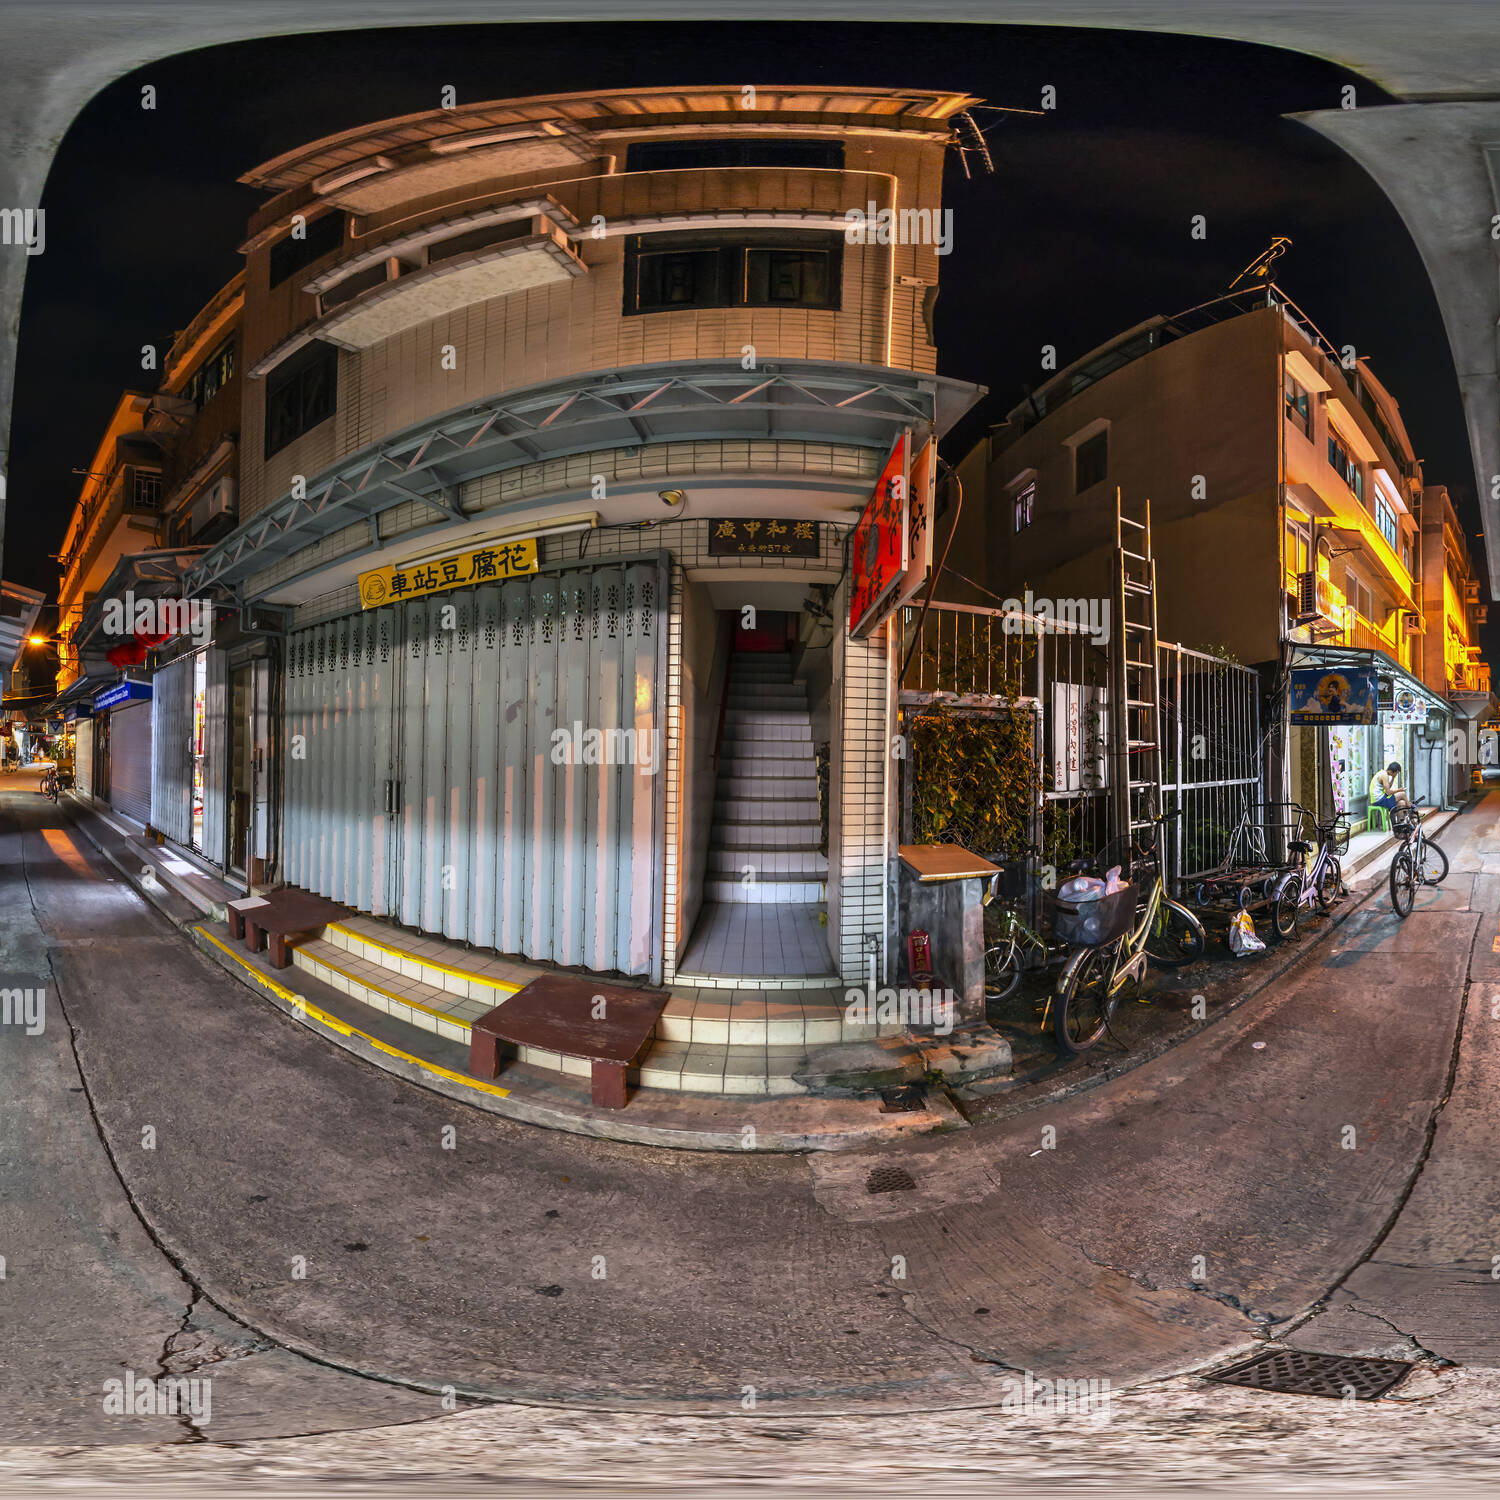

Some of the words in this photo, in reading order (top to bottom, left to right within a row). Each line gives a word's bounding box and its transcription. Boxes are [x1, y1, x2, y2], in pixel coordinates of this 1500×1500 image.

[715, 520, 816, 539] 廣中和樓
[389, 544, 531, 598] 車站豆腐花
